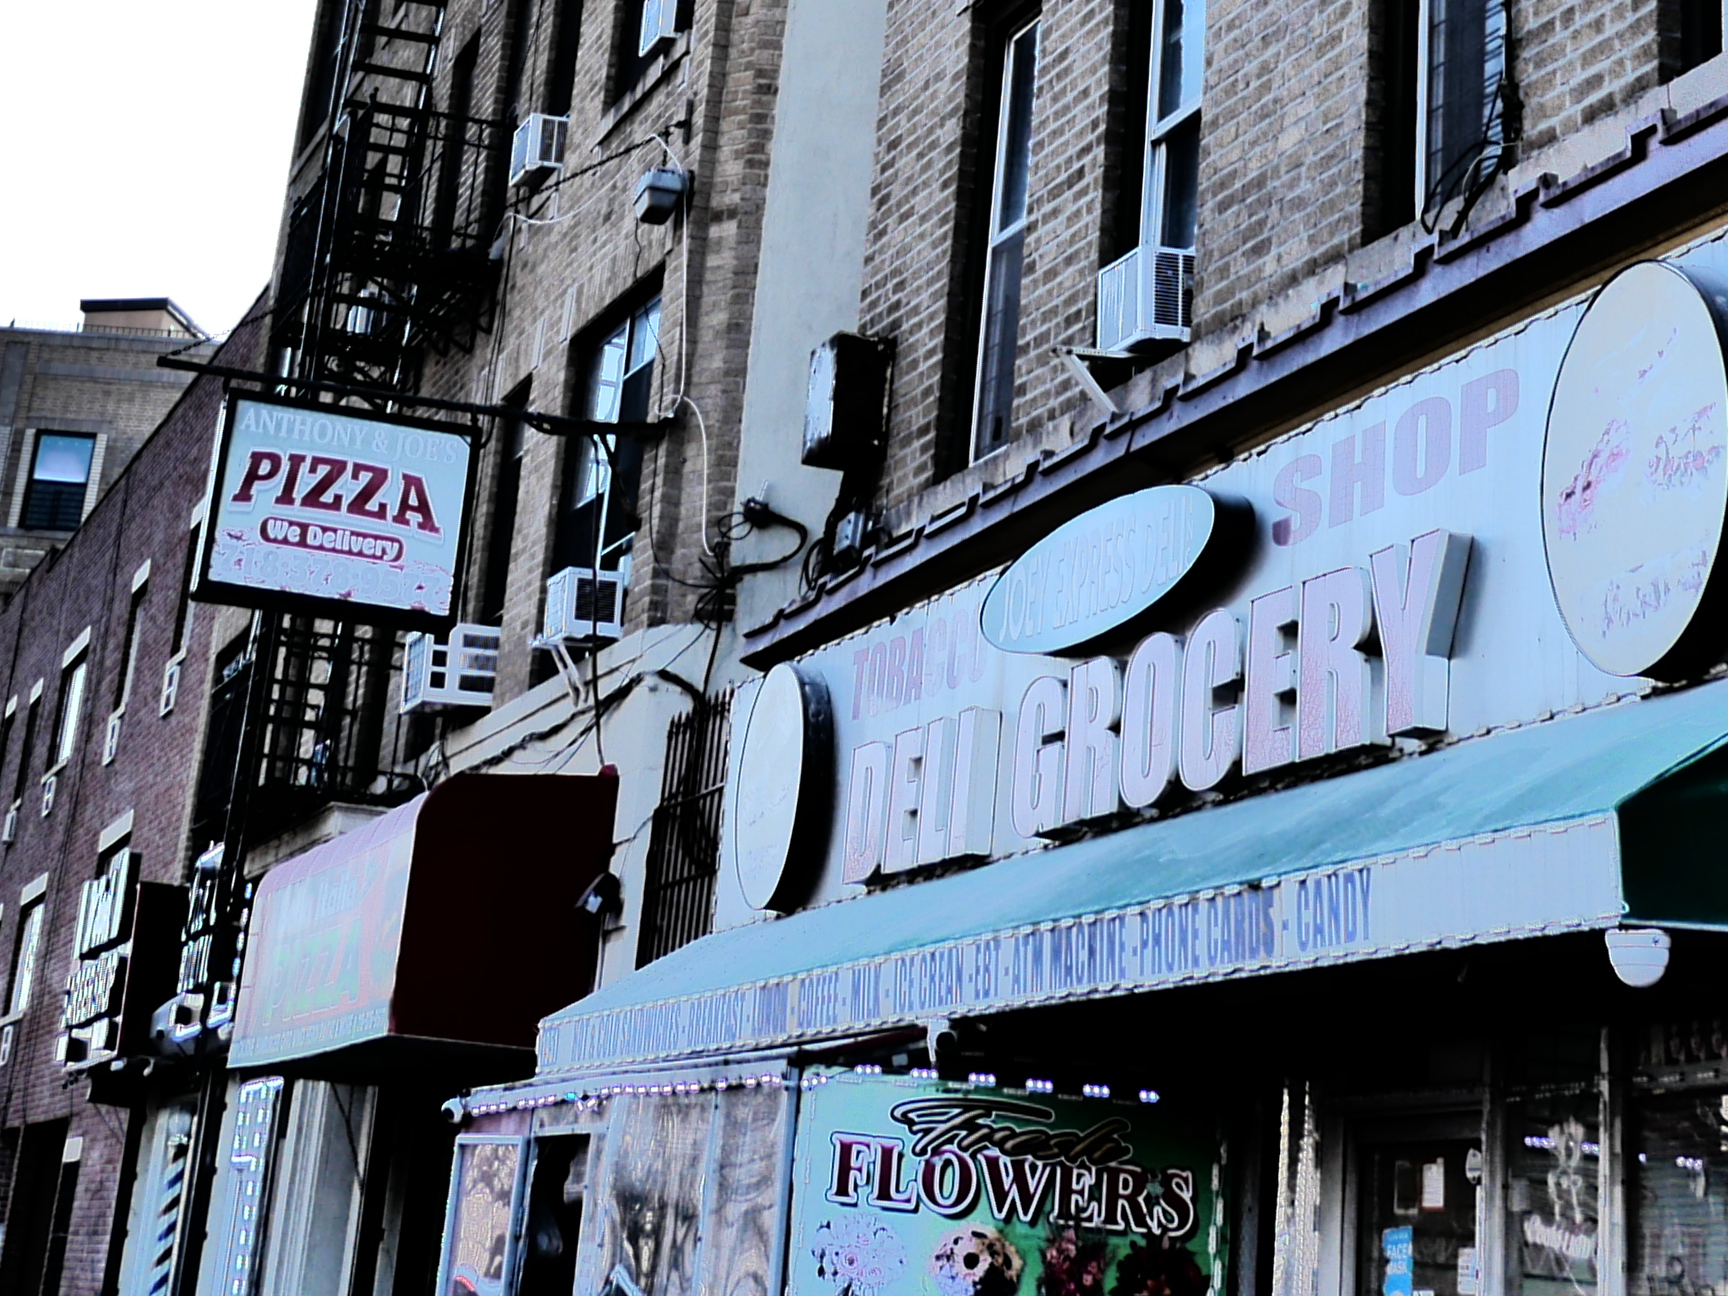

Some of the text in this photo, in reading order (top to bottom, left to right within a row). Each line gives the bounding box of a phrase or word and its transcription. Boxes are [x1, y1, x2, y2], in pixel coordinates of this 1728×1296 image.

[239, 408, 459, 464] ANTHONY & JOE'S
[1272, 368, 1521, 548] SHOP
[229, 450, 443, 538] PIZZA
[266, 517, 400, 562] We Delivery
[998, 549, 1052, 643] JOEY
[1052, 511, 1137, 631] EXPRESS
[1140, 496, 1187, 595] DELI
[842, 528, 1464, 885] DELI GROCERY
[262, 916, 362, 1027] PIZZA
[621, 1003, 682, 1056] SANDWICHES
[686, 990, 746, 1052] BREAKFAST
[798, 971, 839, 1029] COFFEE
[851, 964, 881, 1022] MILK
[893, 954, 916, 1015] ICE
[974, 935, 1001, 1001] EBT
[1011, 925, 1045, 997] ATM
[1047, 913, 1127, 993] MACHINE
[1139, 902, 1201, 977] PHONE
[1205, 887, 1276, 968] CARDS
[1296, 867, 1372, 953] CANDY
[826, 1131, 1194, 1237] FLOWERS
[889, 1095, 1133, 1167] Fresh
